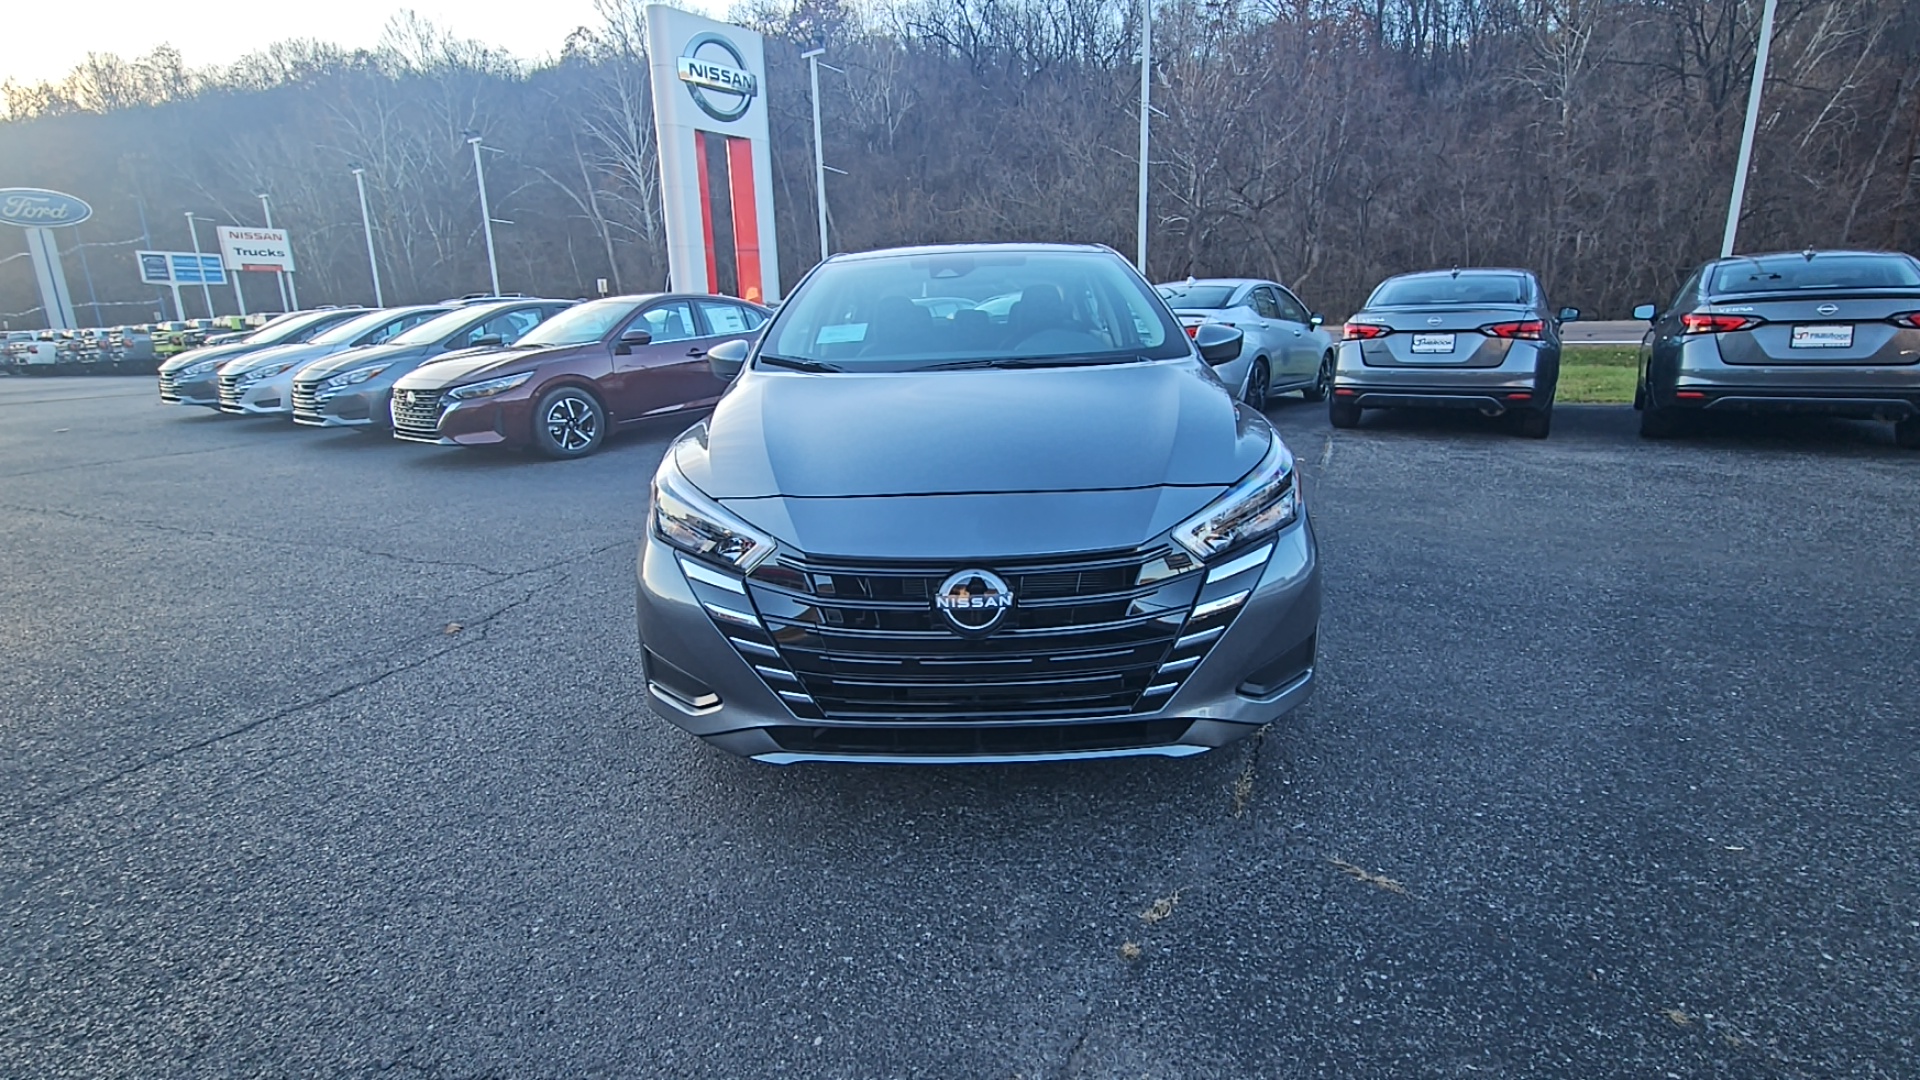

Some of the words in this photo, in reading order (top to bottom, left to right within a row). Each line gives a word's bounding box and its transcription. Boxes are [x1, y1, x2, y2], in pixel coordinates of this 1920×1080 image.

[689, 63, 752, 89] NISSAN
[2, 195, 68, 219] Ford
[229, 231, 282, 241] NISSAN
[233, 247, 285, 257] Trucks
[937, 595, 1012, 608] NISSAN
